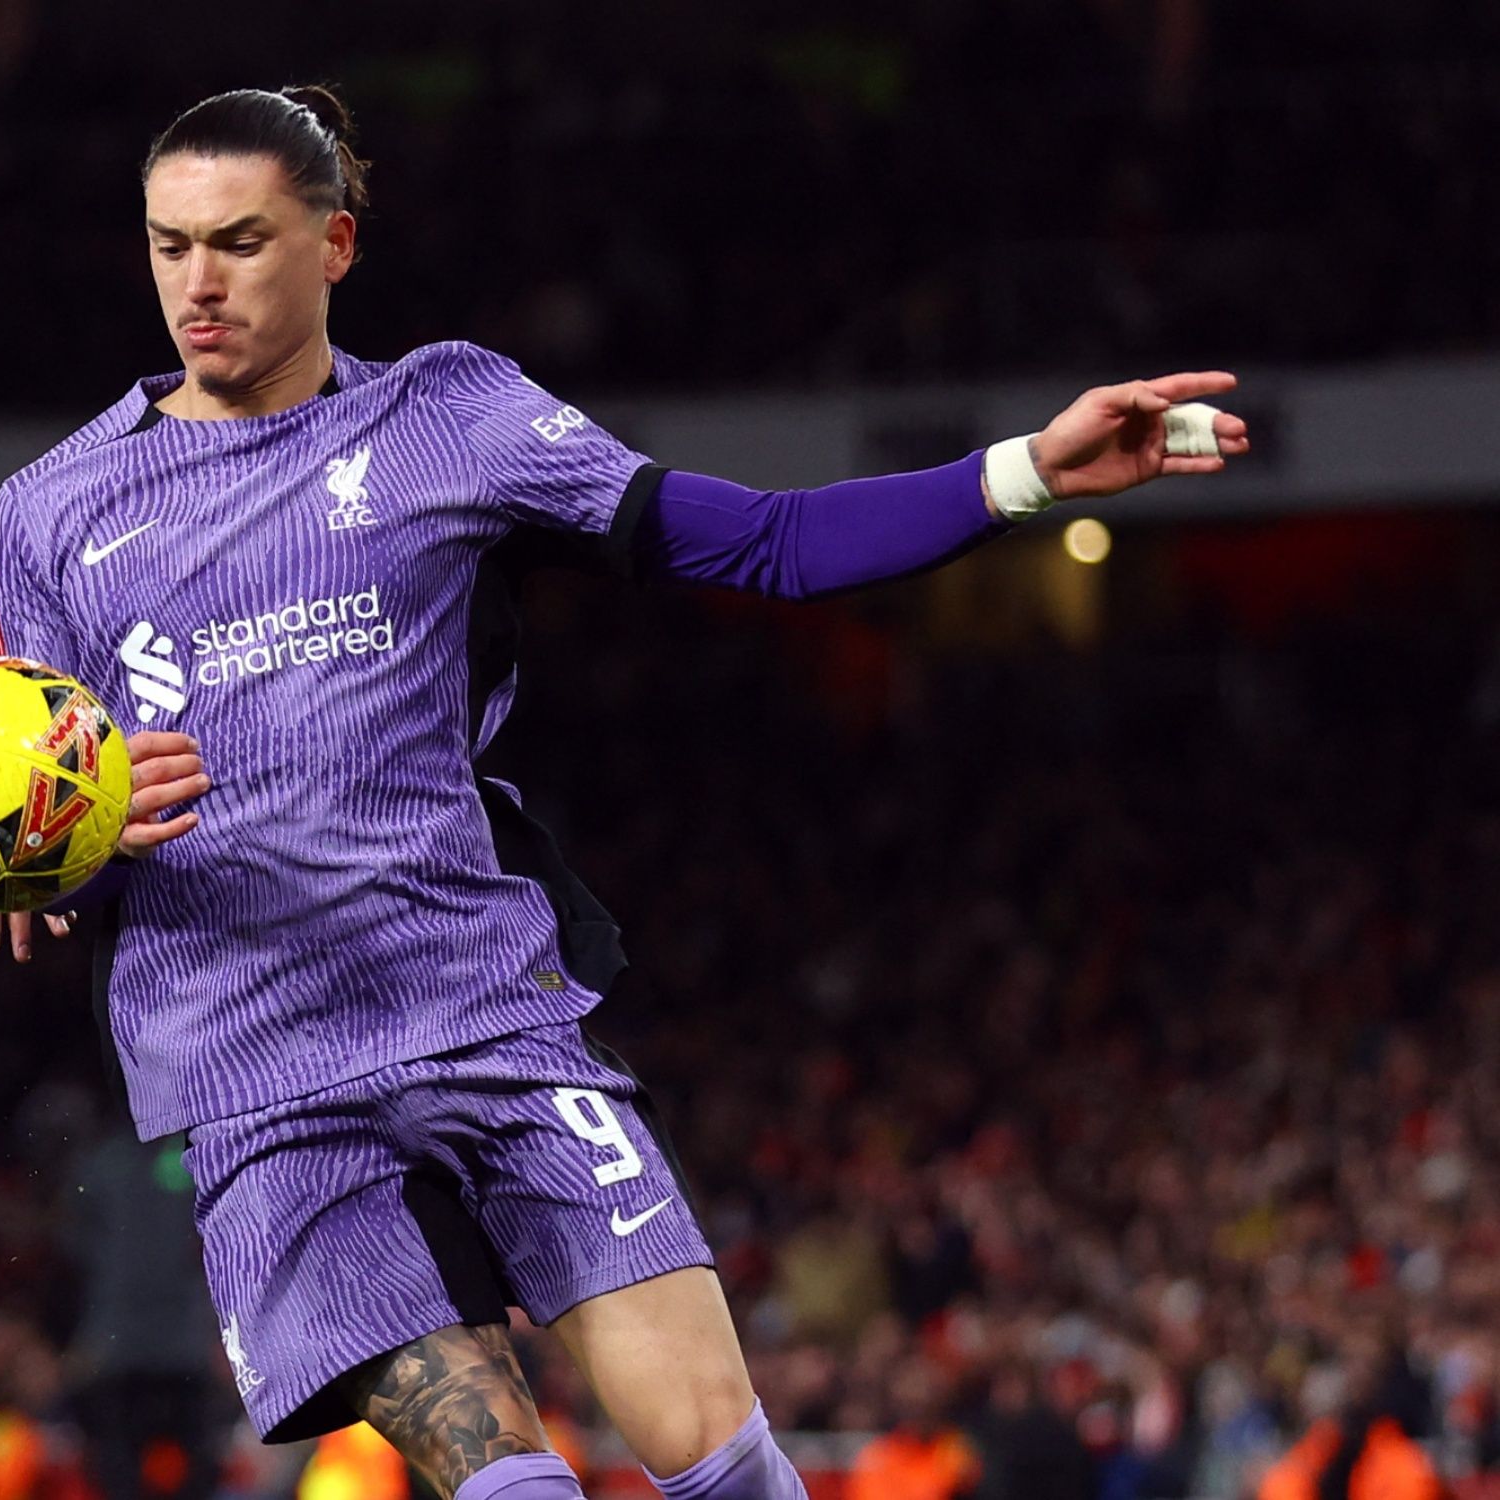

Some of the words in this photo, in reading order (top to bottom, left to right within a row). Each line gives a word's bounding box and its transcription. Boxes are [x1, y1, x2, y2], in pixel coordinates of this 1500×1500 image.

[530, 405, 585, 442] Exp
[192, 584, 380, 656] standard
[198, 617, 394, 686] chartered
[552, 1086, 643, 1188] 9
